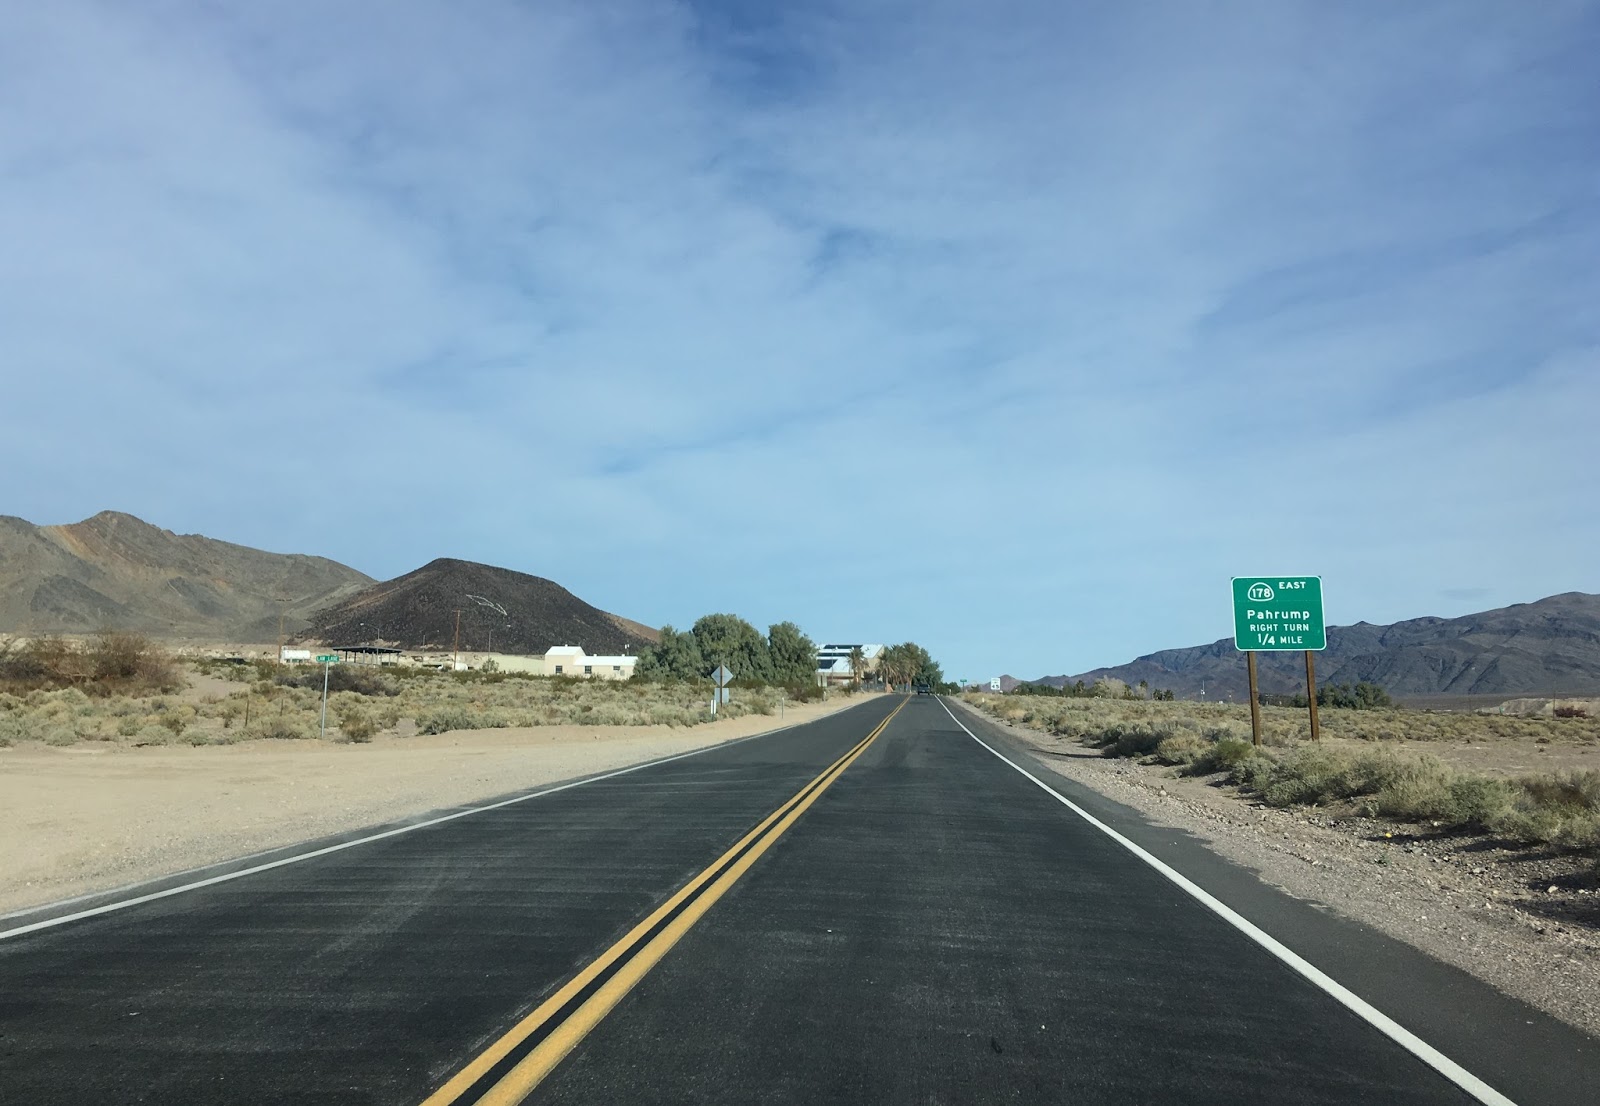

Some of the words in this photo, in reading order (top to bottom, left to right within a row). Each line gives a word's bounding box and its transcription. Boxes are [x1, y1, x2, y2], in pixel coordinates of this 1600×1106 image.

[1278, 581, 1306, 589] EAST
[1252, 588, 1271, 598] 178
[1247, 610, 1310, 620] Pahrump
[1250, 624, 1278, 632] RIGHT
[1283, 624, 1309, 632] TURN
[1257, 633, 1276, 645] 1/4
[1280, 636, 1303, 644] MILE
